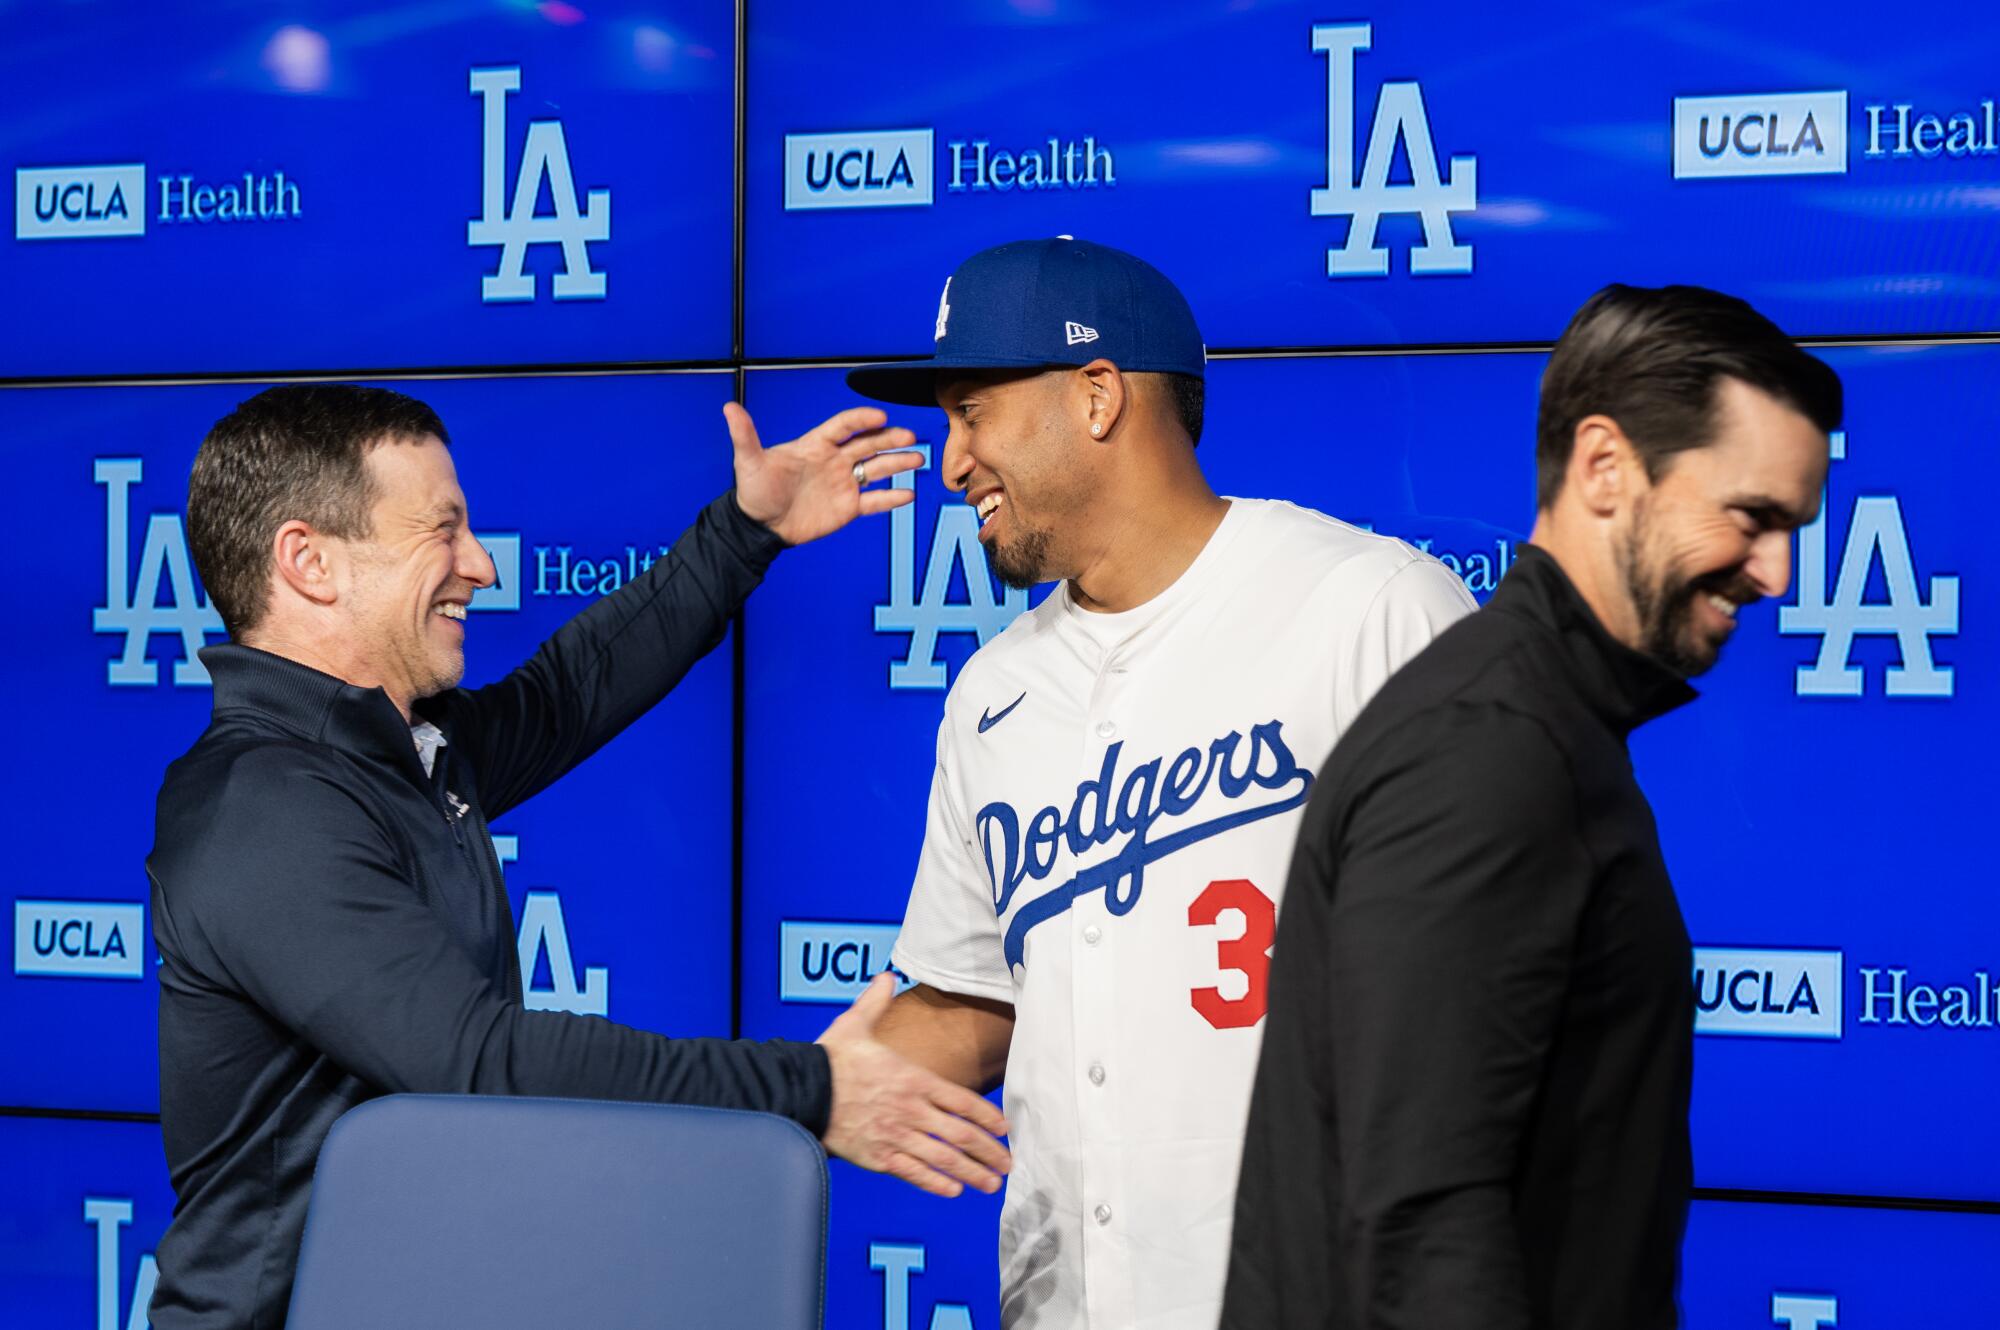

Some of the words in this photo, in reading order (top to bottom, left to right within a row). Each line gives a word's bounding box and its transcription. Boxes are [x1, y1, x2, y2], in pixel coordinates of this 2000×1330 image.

[1700, 110, 1825, 157] UCLA
[1864, 100, 2000, 158] Heal
[806, 146, 914, 192] UCLA
[948, 137, 1115, 191] Health
[34, 181, 129, 221] UCLA
[157, 173, 302, 222] Health
[976, 719, 1316, 918] Dodgers
[33, 919, 127, 959] UCLA
[1695, 969, 1820, 1014] UCLA
[1859, 968, 2000, 1026] Heal
